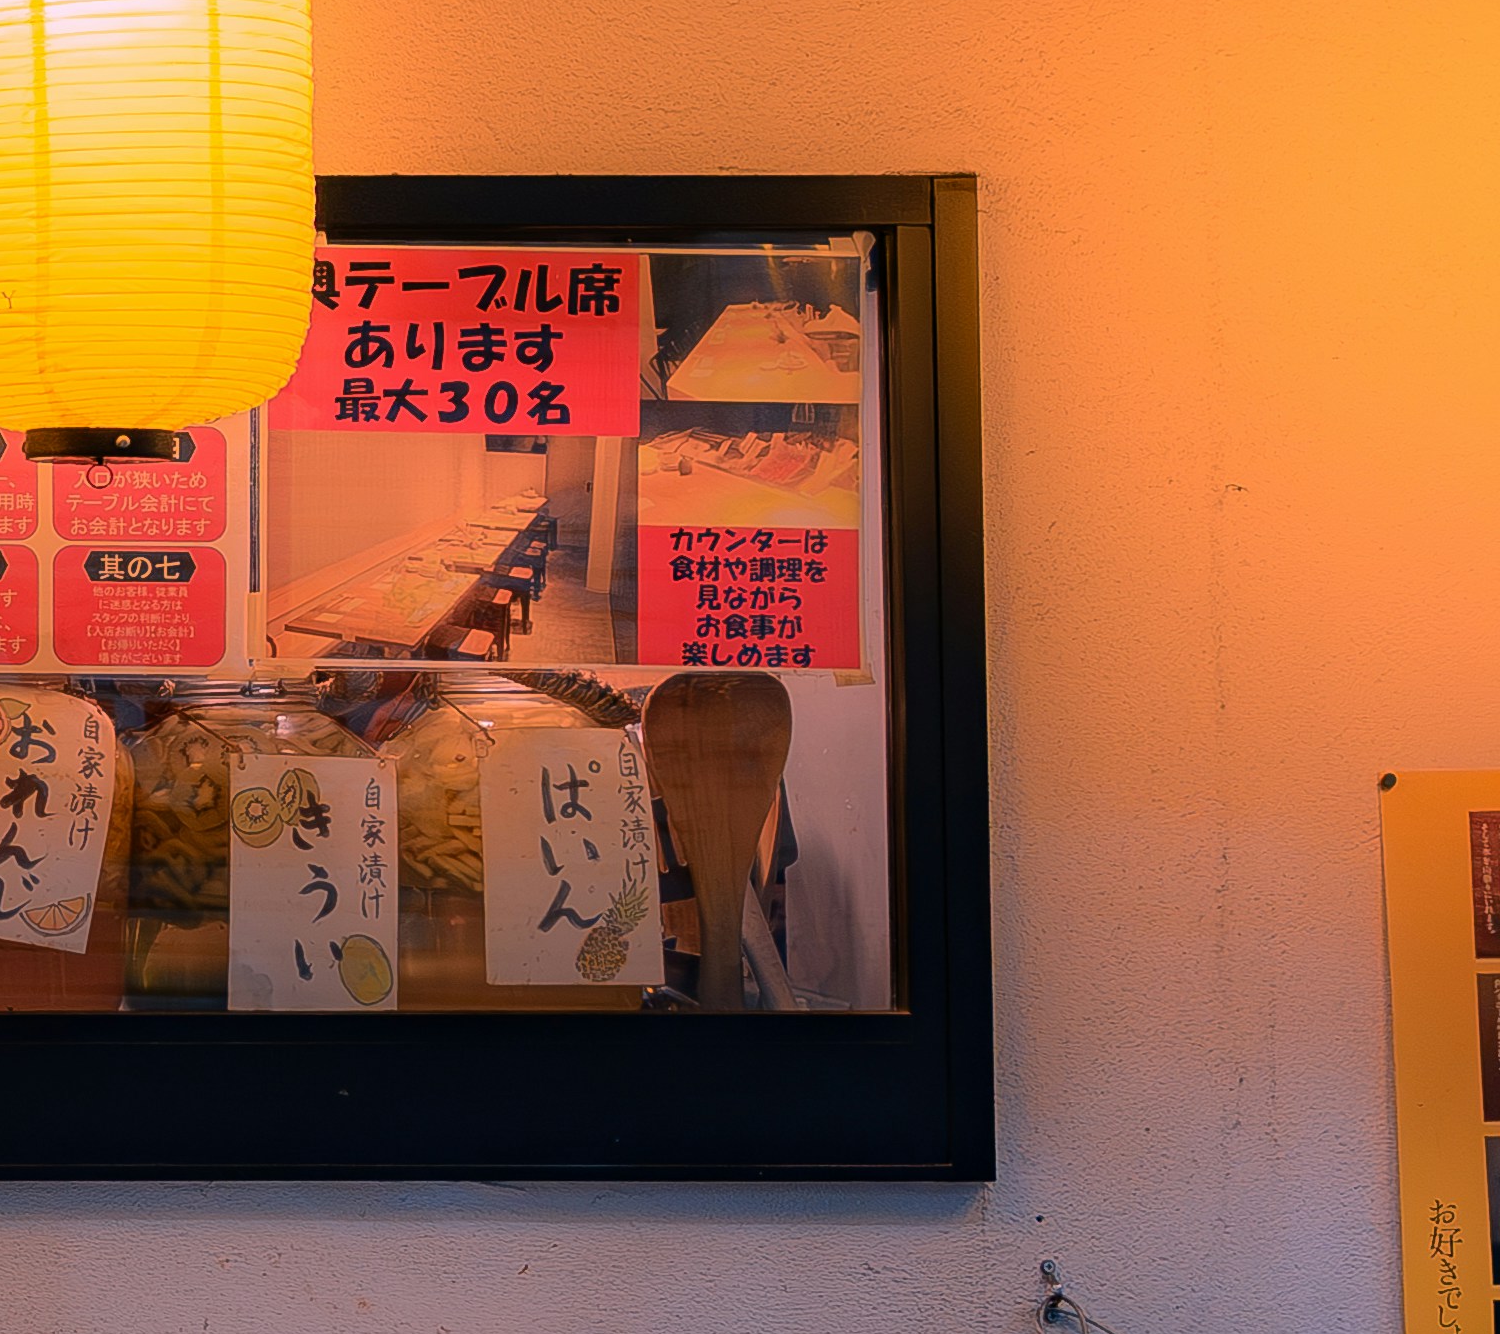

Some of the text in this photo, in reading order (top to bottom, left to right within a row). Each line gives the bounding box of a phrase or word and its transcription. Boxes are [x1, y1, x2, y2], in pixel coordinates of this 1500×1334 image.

[344, 319, 564, 374] あります
[334, 377, 572, 426] 最大30名
[73, 470, 208, 490] 入口が狭いため
[65, 493, 215, 513] テーブル会計にて
[69, 516, 212, 536] お会計となります
[669, 527, 829, 555] カウンターは
[98, 554, 181, 580] 其の七
[669, 555, 829, 584] 食材や調理を
[99, 599, 183, 611] に迷惑となる方は
[695, 584, 802, 611] 見ながら
[696, 613, 803, 641] お食事が
[98, 652, 183, 665] 場合がございます
[681, 640, 817, 668] 楽しめます
[67, 713, 106, 851] 自家漬け
[616, 741, 653, 887] 自家漬け
[357, 776, 390, 921] 自家漬け
[537, 759, 606, 934] ぱいん
[291, 790, 345, 983] きうい
